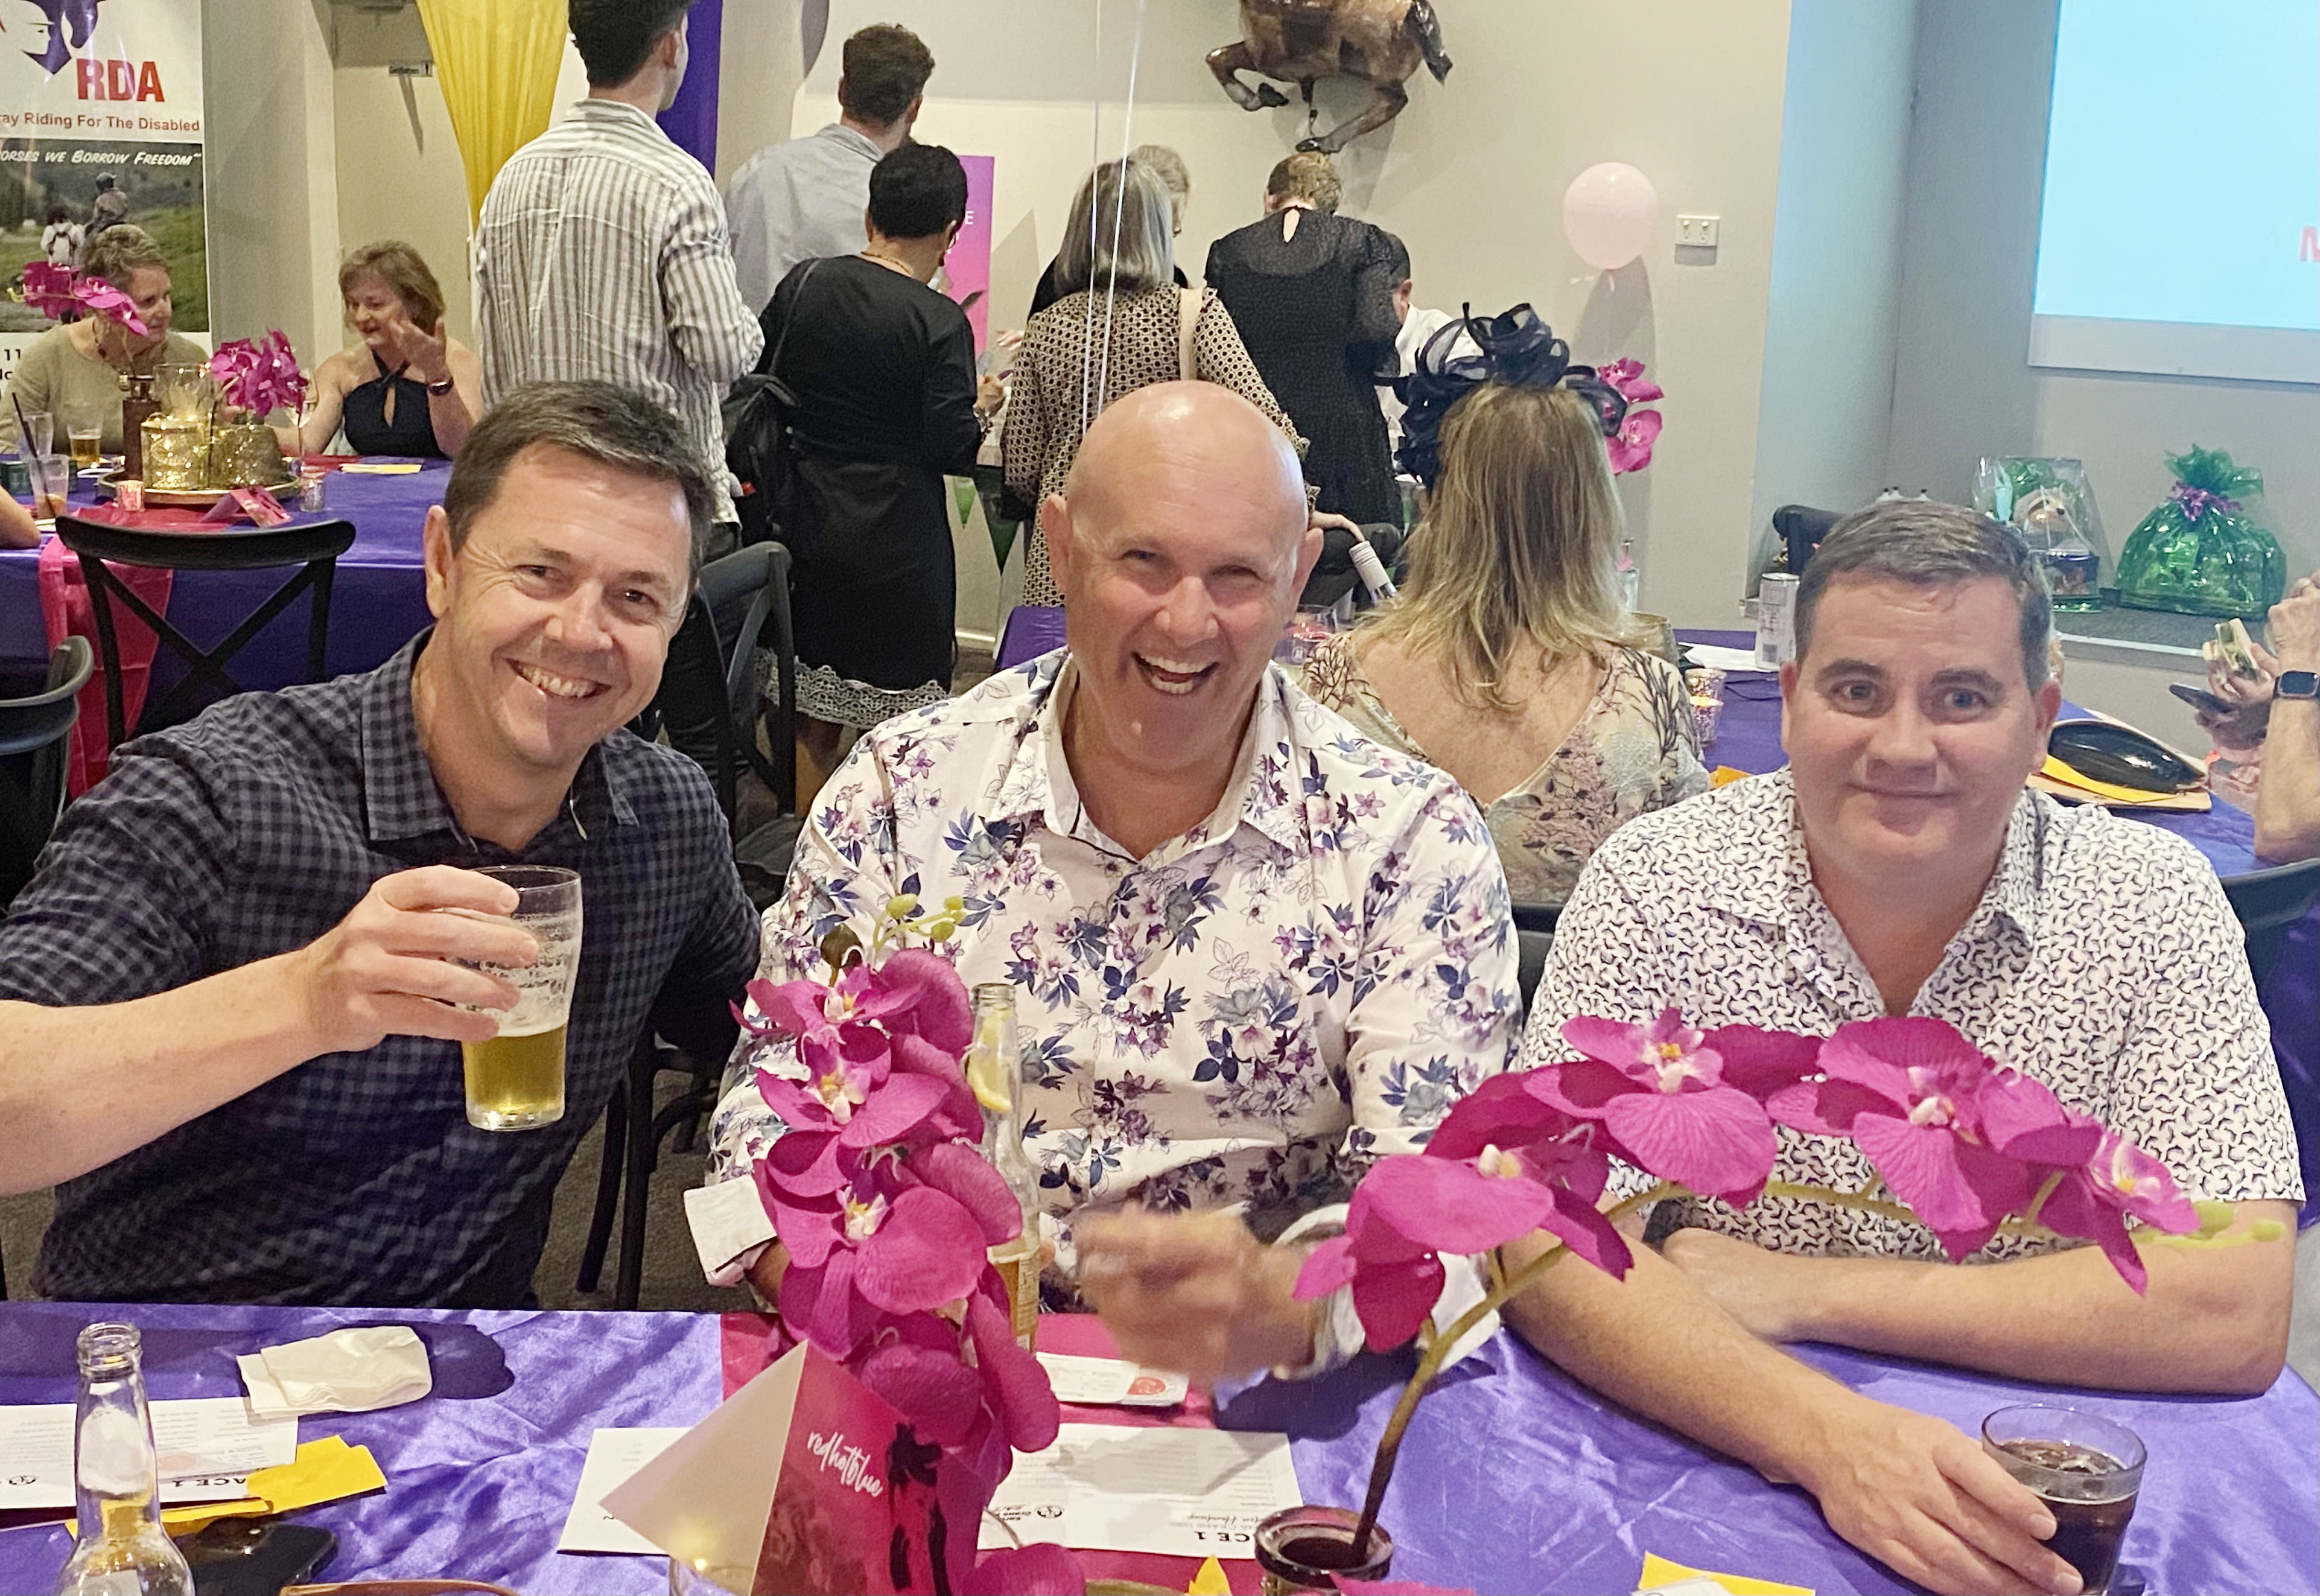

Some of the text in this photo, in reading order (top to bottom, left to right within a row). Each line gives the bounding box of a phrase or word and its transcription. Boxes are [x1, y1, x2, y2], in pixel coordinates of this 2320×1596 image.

[77, 59, 165, 102] RDA
[24, 112, 72, 129] Riding
[77, 115, 102, 127] For
[106, 116, 133, 129] The
[139, 118, 200, 131] Disabled
[71, 150, 130, 164] BORROW
[196, 1478, 246, 1486] ACE
[1217, 1532, 1250, 1542] CE
